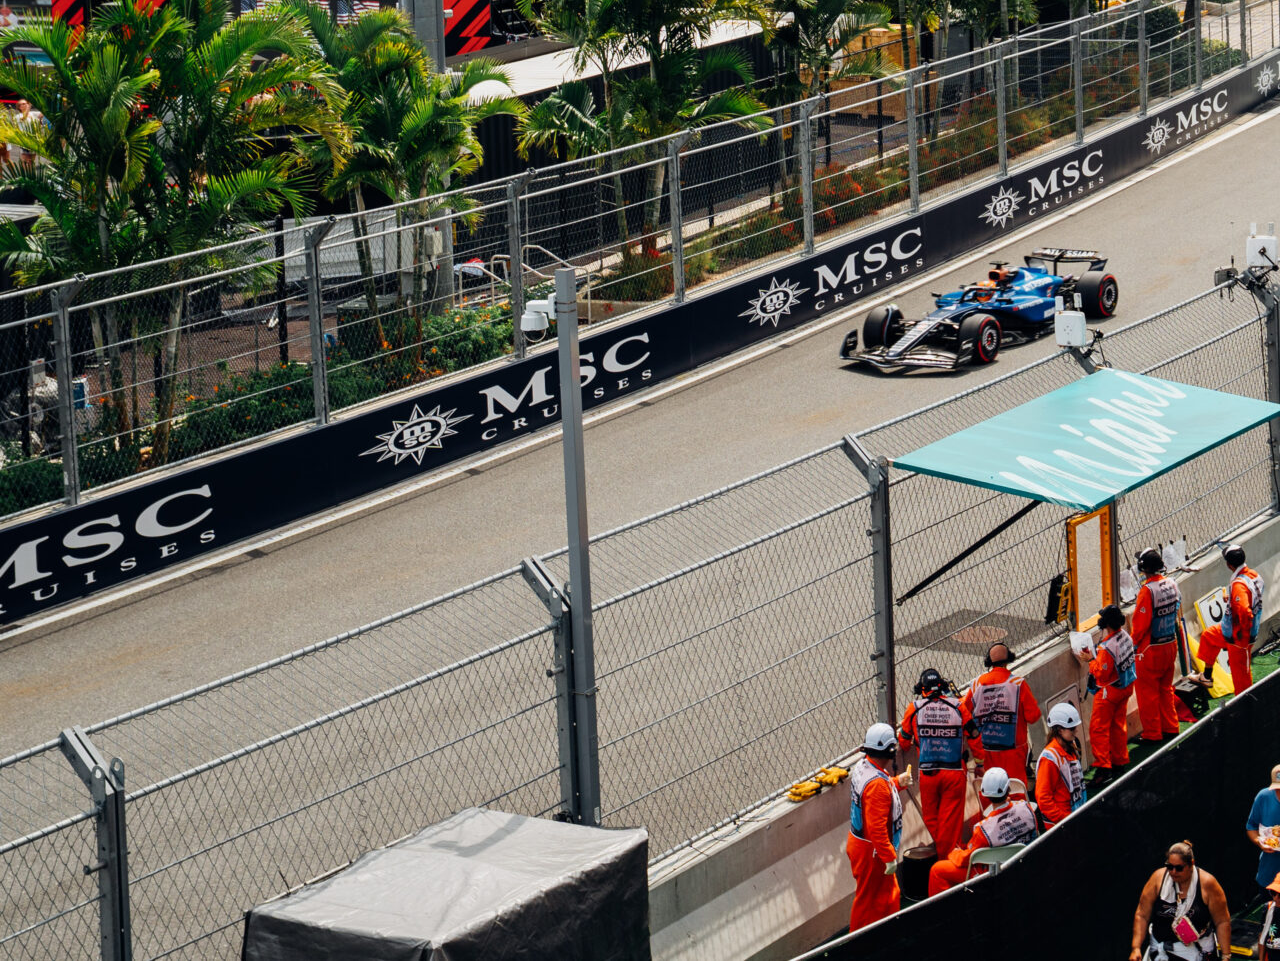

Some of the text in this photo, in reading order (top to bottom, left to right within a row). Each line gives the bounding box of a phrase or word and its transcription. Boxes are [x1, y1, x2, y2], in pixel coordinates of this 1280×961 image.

[1176, 89, 1228, 134] MSC
[1176, 112, 1229, 145] CRUISES
[1028, 149, 1103, 204] MSC
[1028, 176, 1104, 216] CRUISES
[813, 226, 922, 297] MSC
[1043, 248, 1095, 257] ATLSSIAN
[815, 258, 924, 311] CRUISES
[481, 369, 652, 441] CRUSES
[0, 529, 216, 614] UISES
[919, 728, 957, 737] COURSE
